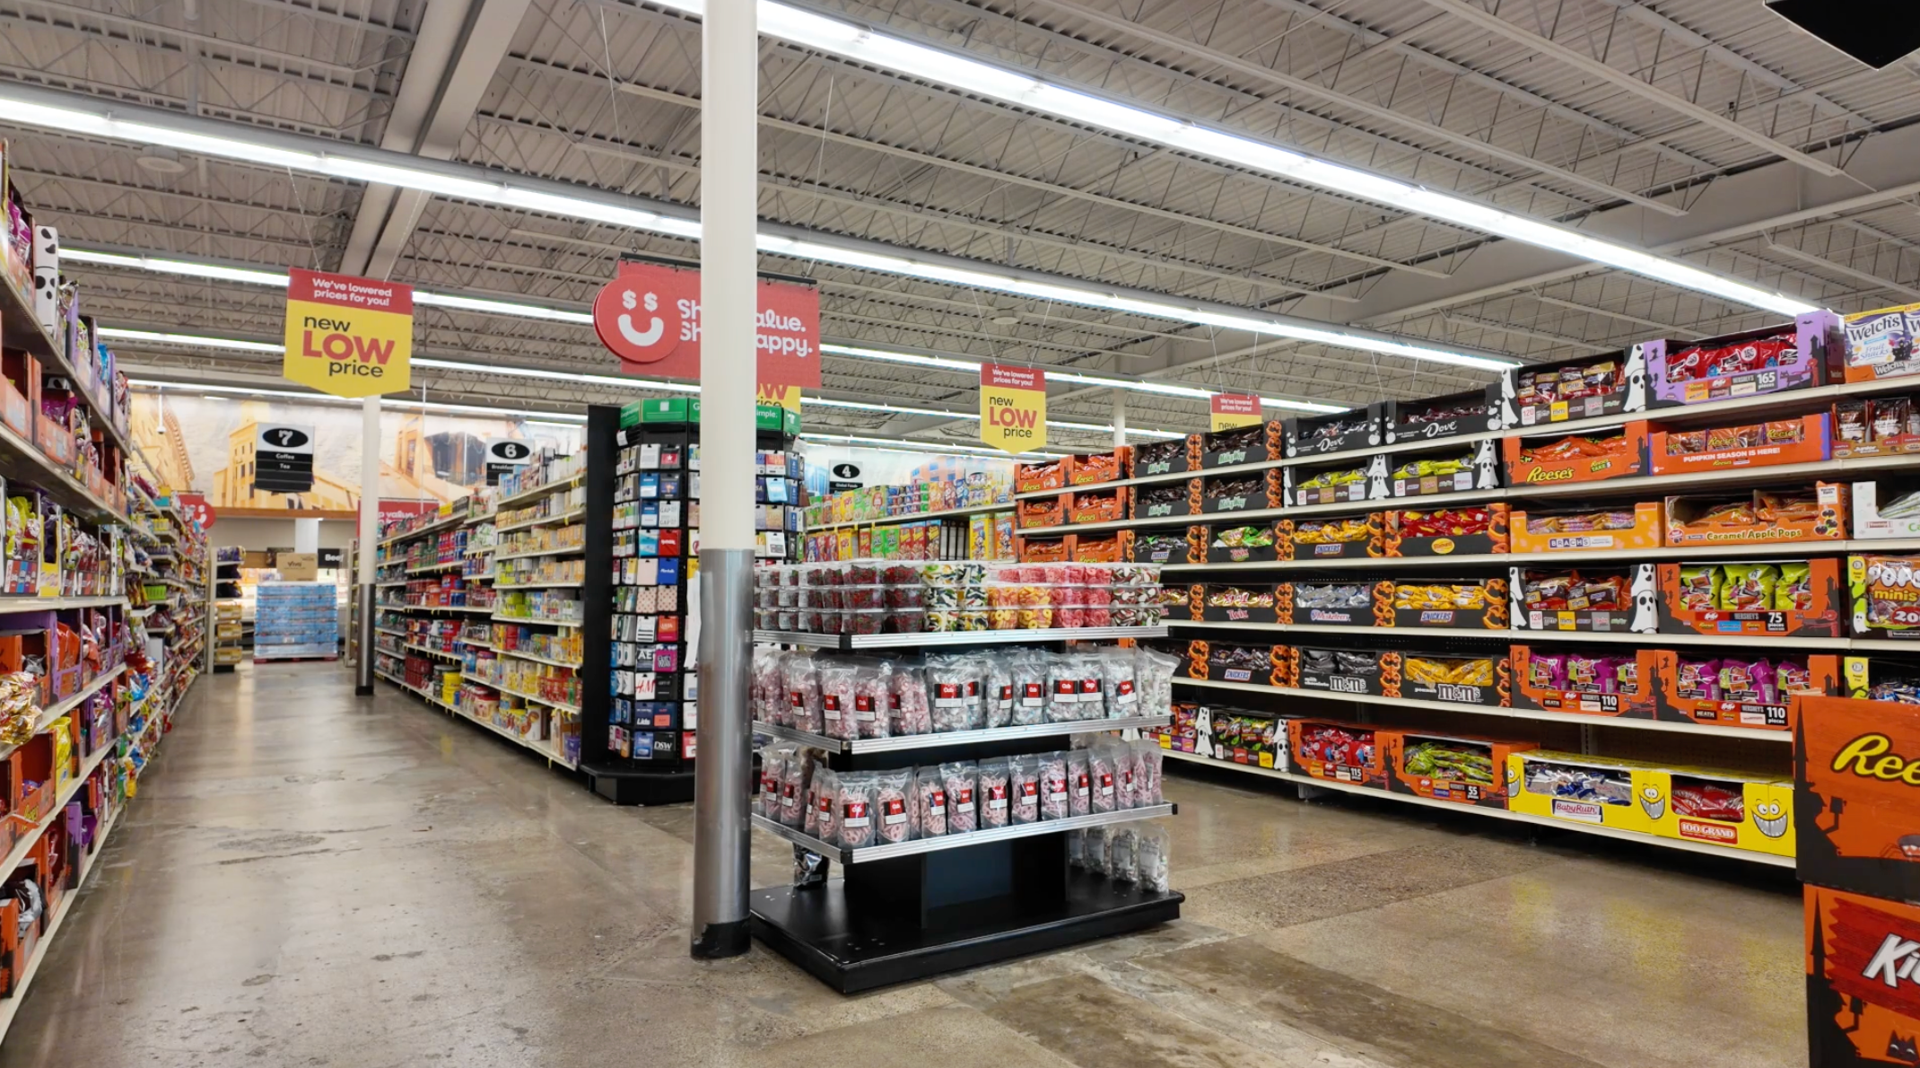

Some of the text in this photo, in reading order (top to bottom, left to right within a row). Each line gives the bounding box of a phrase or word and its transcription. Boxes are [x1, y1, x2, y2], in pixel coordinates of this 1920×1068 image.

[312, 278, 393, 298] We've lowered
[314, 290, 390, 307] prices for you!
[677, 299, 806, 332] Sh alue.
[304, 316, 351, 332] new
[1849, 315, 1901, 341] Welch's
[680, 322, 813, 358] Sh appy.
[302, 330, 396, 365] LOW
[1865, 343, 1885, 352] Fruit
[328, 359, 384, 378] price
[992, 369, 1034, 380] We've lowered
[993, 377, 1011, 385] prices
[1757, 371, 1776, 384] 165
[989, 396, 1014, 407] new
[989, 406, 1038, 429] LOW
[1003, 425, 1033, 439] price
[1421, 420, 1458, 438] Dove
[278, 429, 294, 446] 7
[1316, 436, 1346, 452] Dove
[504, 443, 517, 458] 6
[1683, 453, 1716, 463] PUMPKIN
[1716, 450, 1748, 460] SEASON
[1757, 447, 1781, 456] HERE!
[842, 465, 851, 478] 4
[1526, 466, 1575, 482] Reese's
[1706, 530, 1746, 541] Caramel
[1747, 529, 1776, 541] Apple
[1777, 529, 1803, 541] Pops
[1873, 589, 1918, 602] minis
[1226, 609, 1249, 621] Twix
[1421, 611, 1453, 622] SNICKERS
[1768, 612, 1783, 623] 75
[1601, 695, 1617, 706] 110
[1696, 710, 1715, 718] HEATH
[1766, 706, 1786, 719] 110
[653, 741, 672, 750] DSW
[1681, 822, 1735, 838] 100 GRAND
